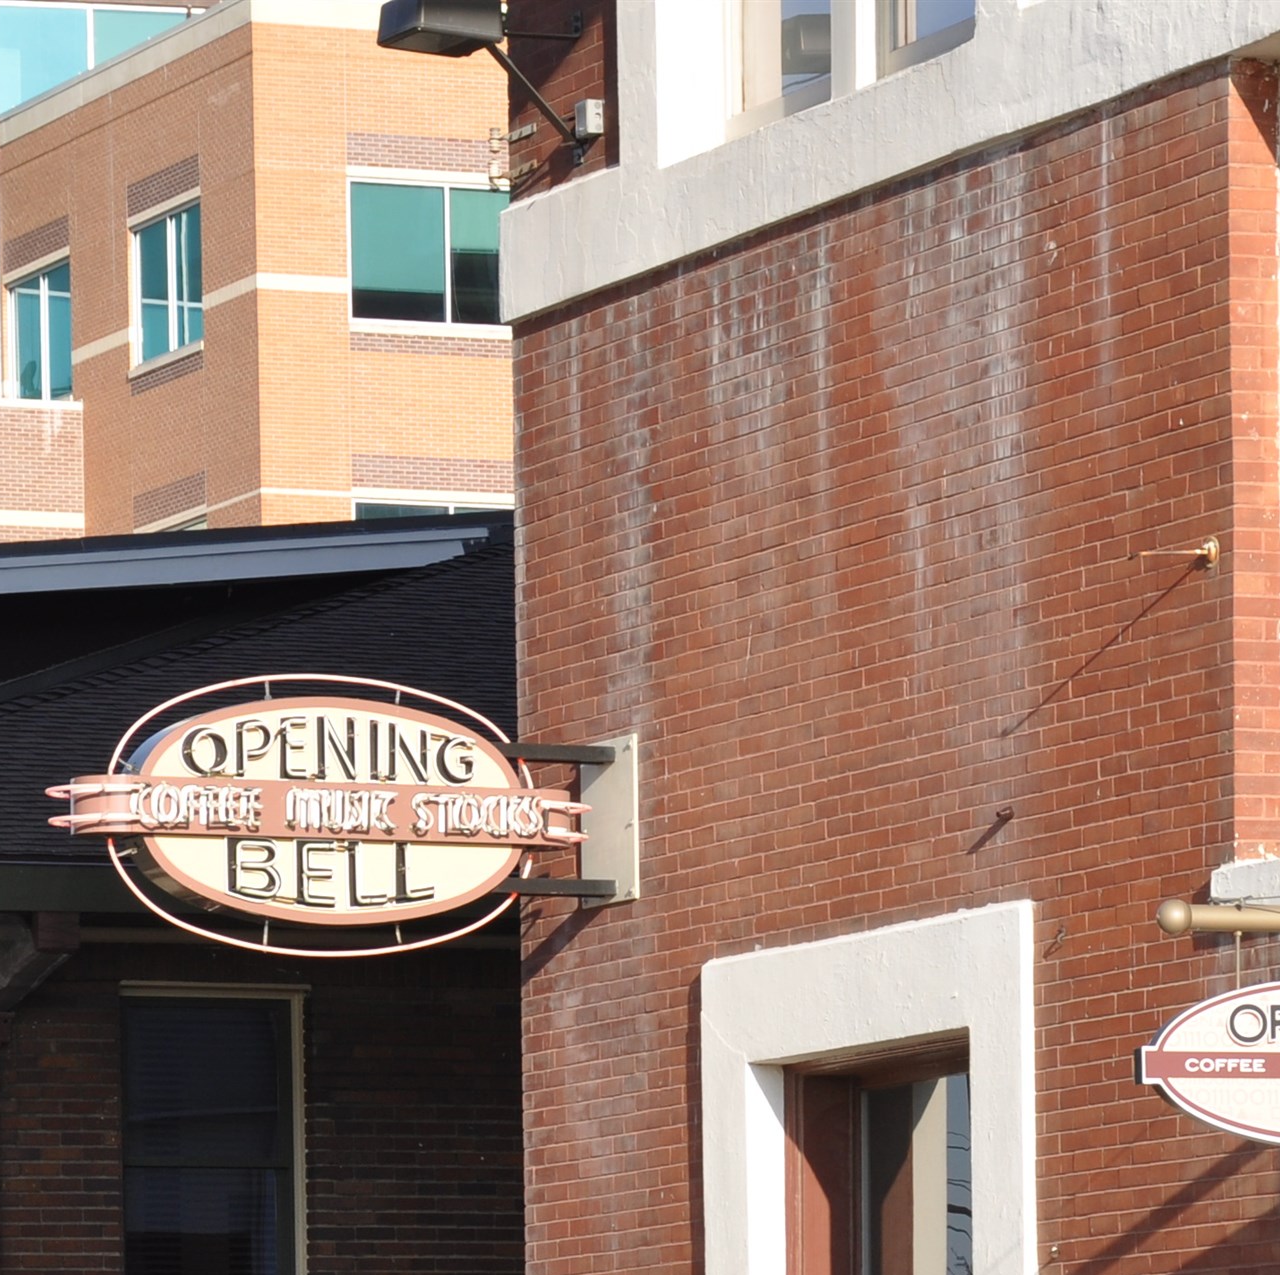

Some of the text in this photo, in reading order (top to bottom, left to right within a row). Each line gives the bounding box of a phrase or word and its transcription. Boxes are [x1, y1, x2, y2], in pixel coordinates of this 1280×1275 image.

[180, 715, 476, 785] OPENING
[130, 781, 544, 838] COFFEE MUSIC STOCKS
[224, 838, 436, 908] BELL
[1184, 1057, 1266, 1074] COFFEE
